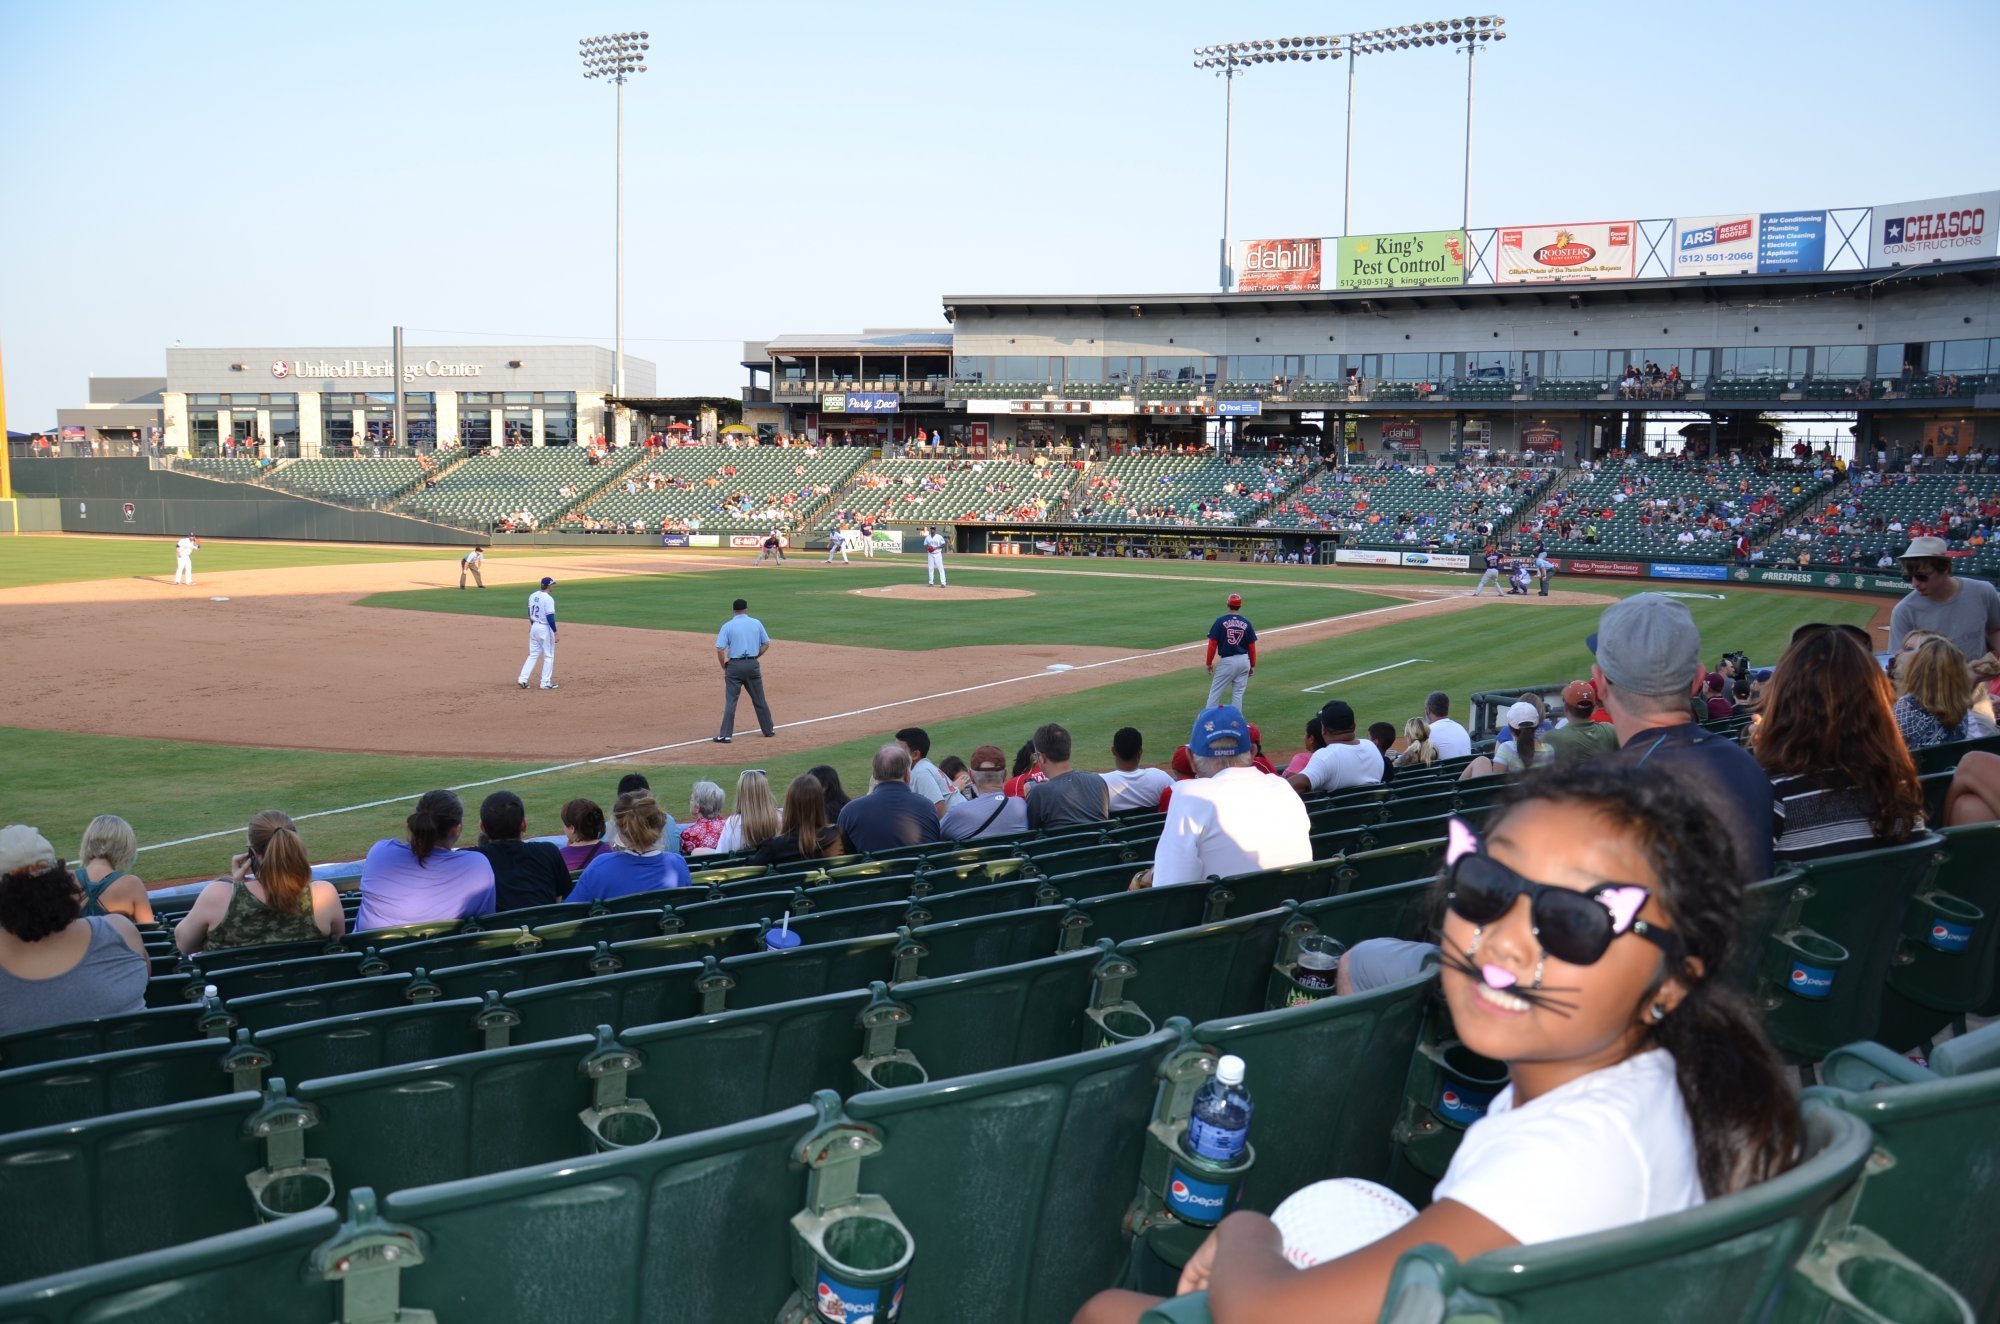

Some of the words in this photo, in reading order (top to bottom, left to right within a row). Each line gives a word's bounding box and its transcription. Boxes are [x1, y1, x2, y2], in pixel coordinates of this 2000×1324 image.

[1780, 215, 1822, 223] Conditioning
[1905, 208, 1984, 242] CHASCO
[1720, 229, 1748, 240] ROOTER
[1721, 223, 1748, 234] RESCUE
[1684, 229, 1713, 246] ARS
[1786, 232, 1816, 240] Cleaning
[1376, 236, 1424, 257] King's
[1884, 235, 1982, 255] CONSTRUCTORS
[1247, 243, 1309, 270] dahill
[1539, 247, 1590, 260] ROOSTERS
[1678, 253, 1703, 263] (512)
[1706, 252, 1753, 262] 501-2066
[1353, 259, 1382, 275] Pest
[1388, 255, 1445, 274] Control
[1340, 278, 1394, 287] 512-930-5128
[1401, 276, 1459, 286] kingspest.com
[295, 361, 349, 378] United
[352, 360, 424, 382] Heritge
[425, 360, 482, 377] Center
[849, 398, 872, 410] Party
[874, 400, 896, 409] Deck
[1390, 428, 1414, 438] dahill
[1762, 572, 1812, 582] #RREXPRESS
[532, 605, 539, 618] 12
[1227, 629, 1244, 645] 57
[1807, 978, 1832, 986] pepsi
[1189, 1195, 1223, 1207] pepsi
